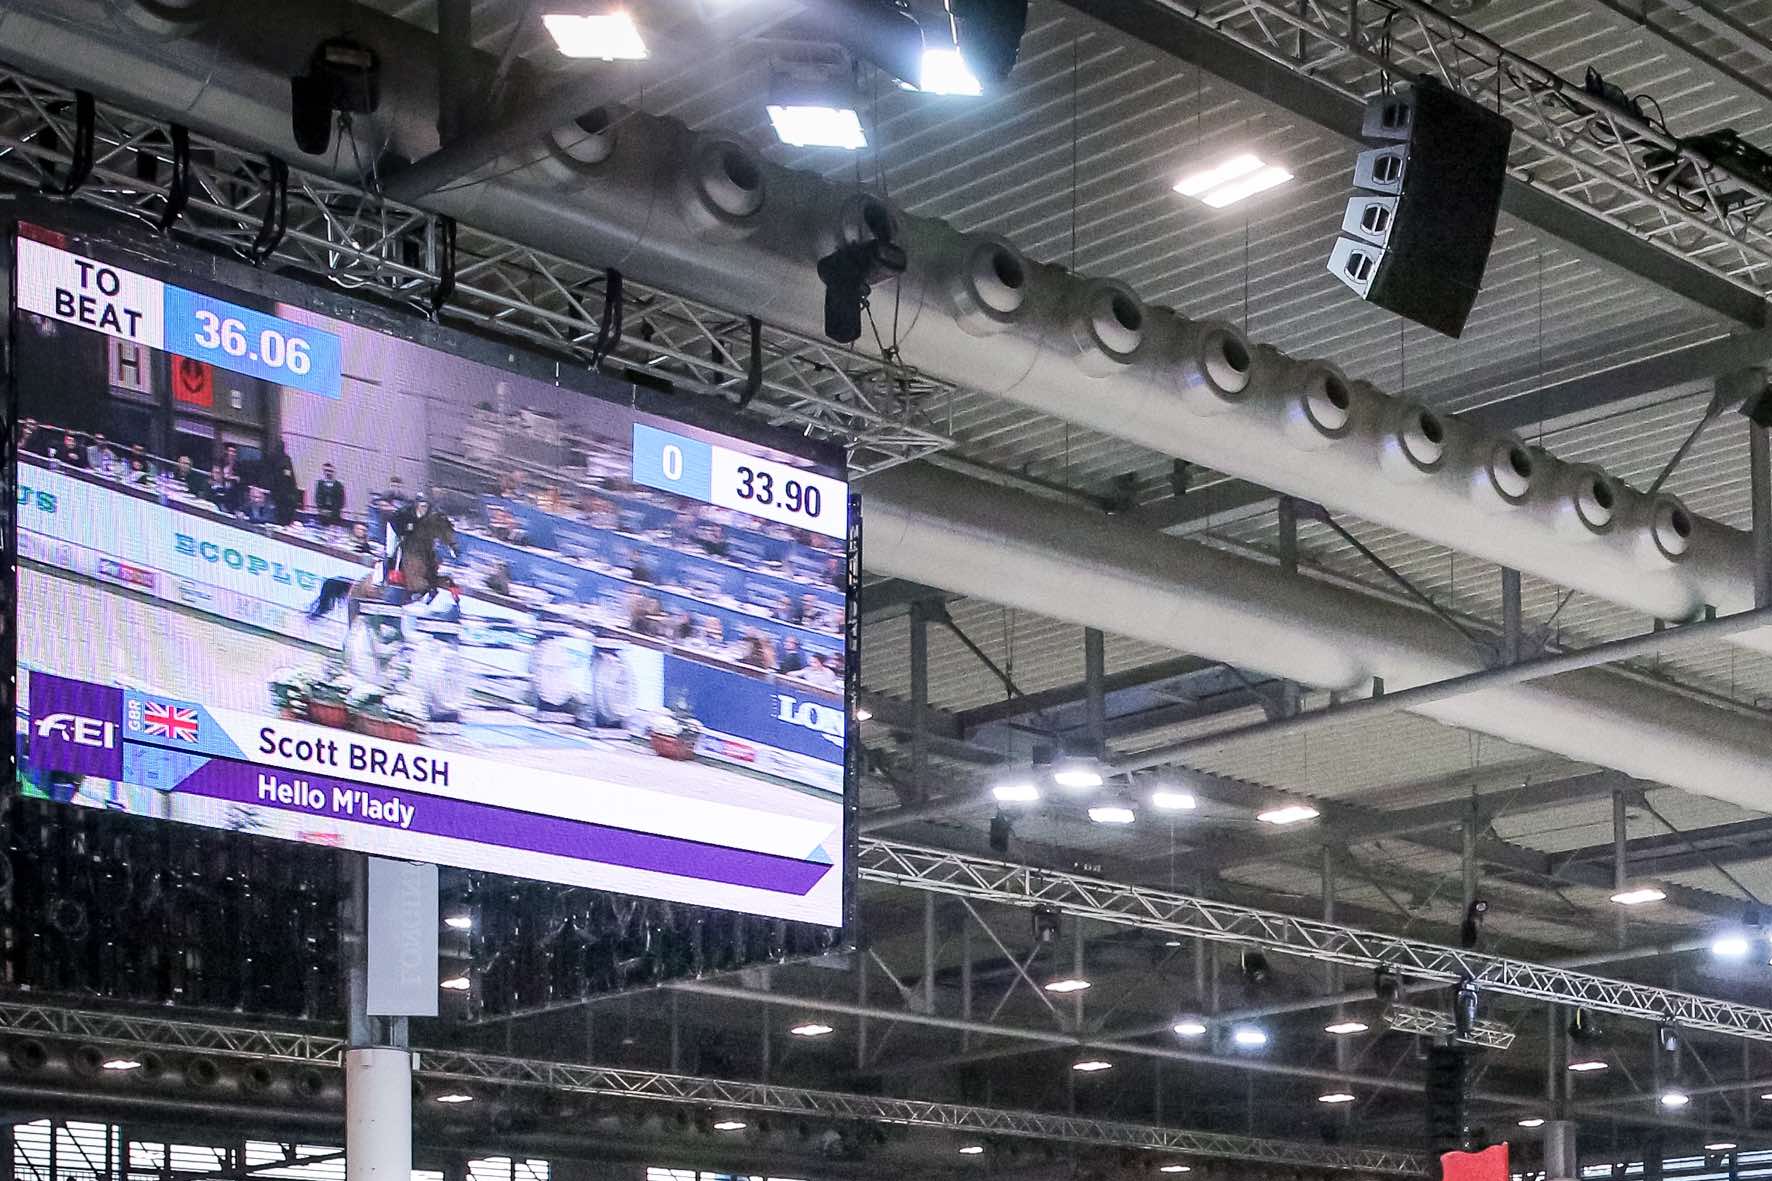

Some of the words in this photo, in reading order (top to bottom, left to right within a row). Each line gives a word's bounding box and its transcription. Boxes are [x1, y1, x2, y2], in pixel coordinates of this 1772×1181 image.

[75, 259, 120, 296] TO
[55, 287, 142, 337] BEAT
[194, 310, 311, 376] 36.06
[662, 444, 683, 481] 0
[736, 466, 822, 518] 33.90
[174, 532, 323, 590] ECOPLU
[35, 713, 117, 749] FEI
[127, 699, 143, 732] GBR
[259, 726, 338, 765] Scott
[349, 745, 450, 787] BRASH
[258, 774, 325, 811] Hello
[333, 790, 415, 829] M'lady
